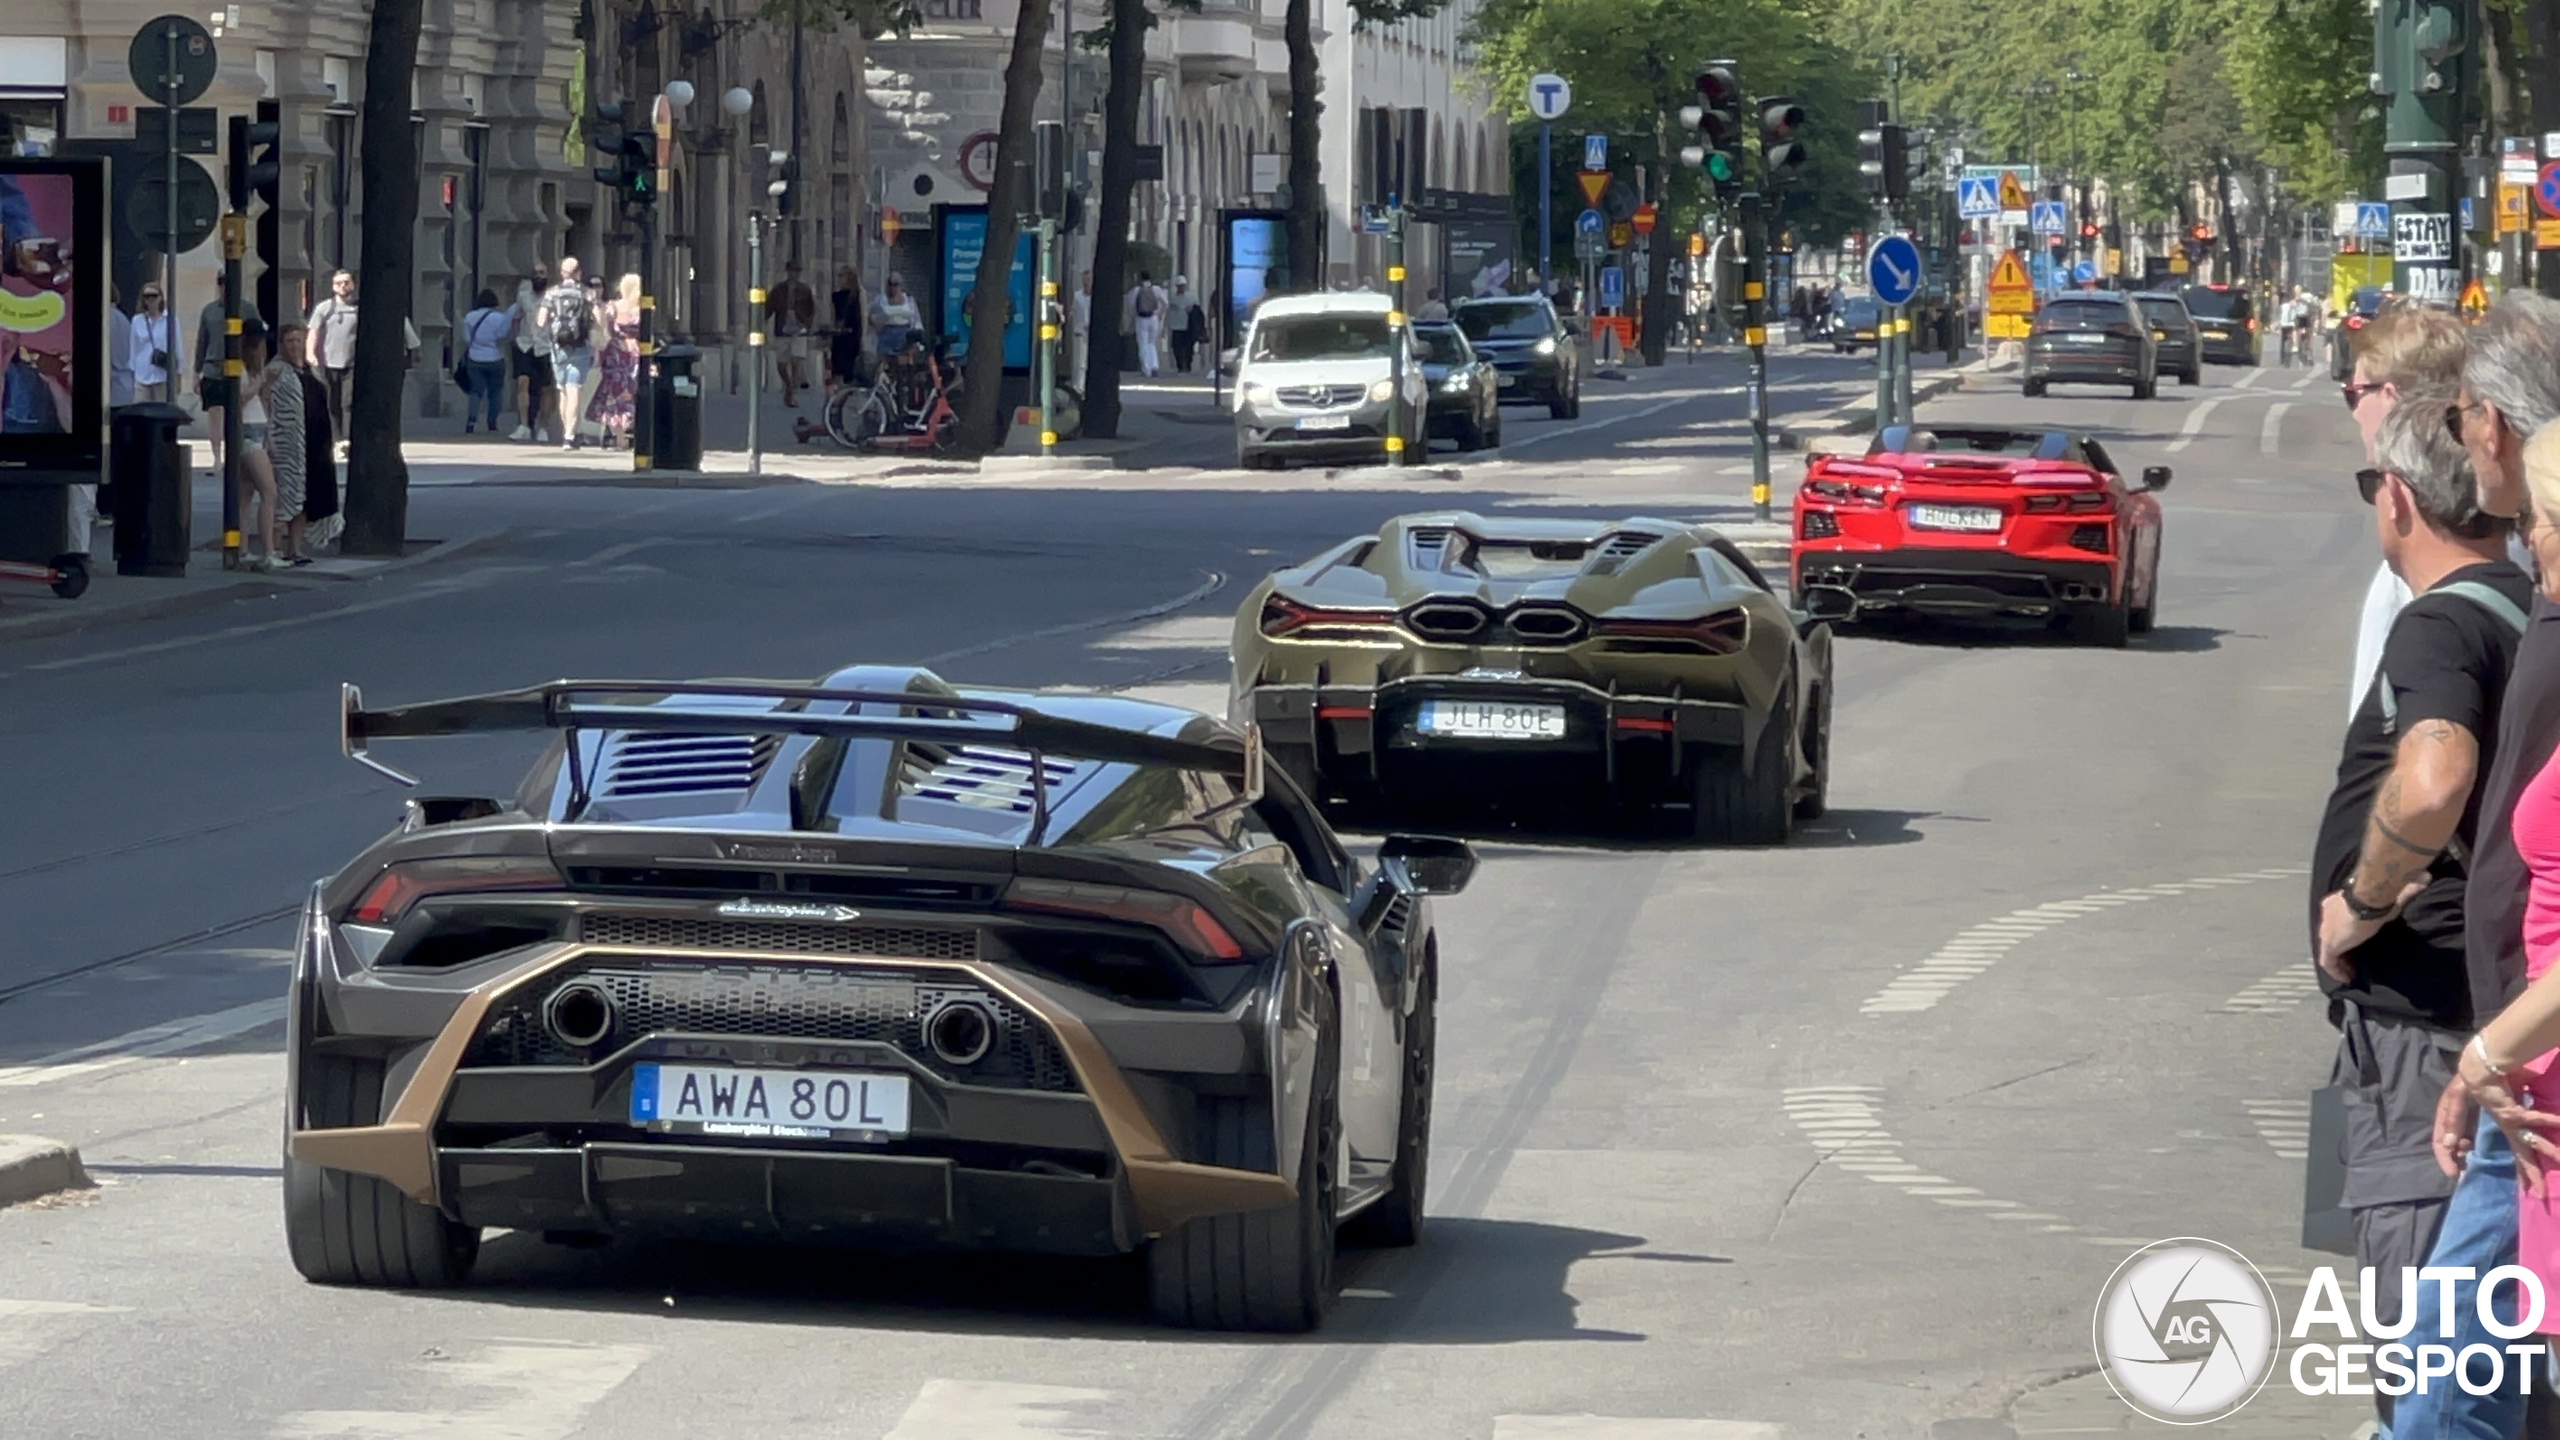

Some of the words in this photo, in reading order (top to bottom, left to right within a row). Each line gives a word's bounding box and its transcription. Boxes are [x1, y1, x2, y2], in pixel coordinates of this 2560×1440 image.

[1536, 84, 1562, 114] T
[1445, 705, 1494, 729] JLH
[1503, 707, 1552, 731] 80E
[676, 1072, 770, 1119] AWA
[790, 1078, 883, 1124] 80L
